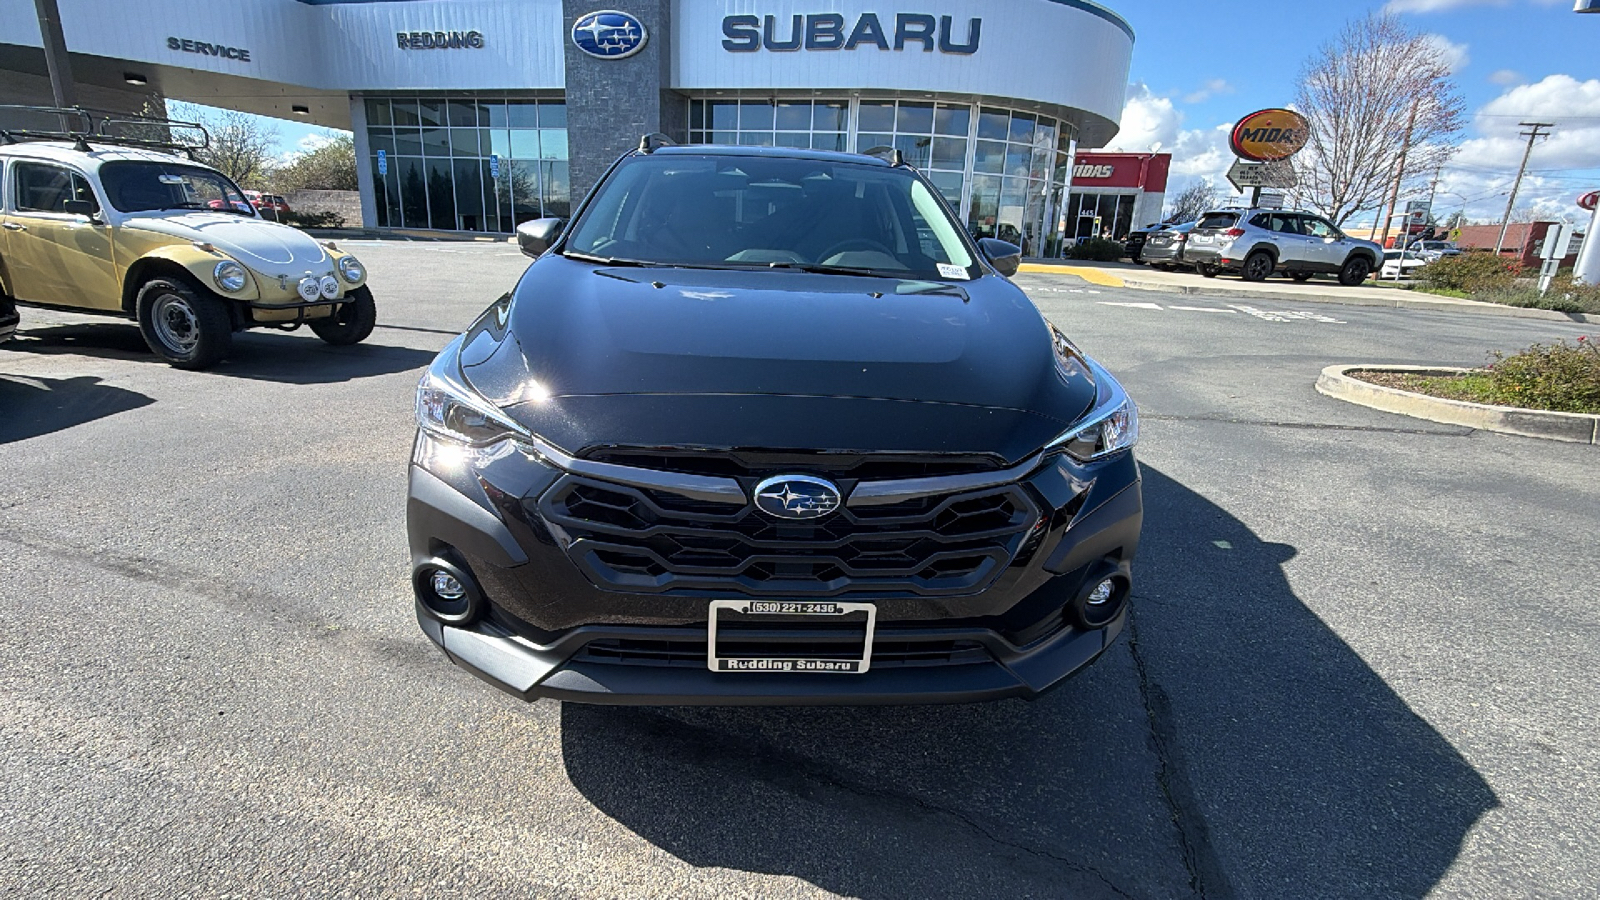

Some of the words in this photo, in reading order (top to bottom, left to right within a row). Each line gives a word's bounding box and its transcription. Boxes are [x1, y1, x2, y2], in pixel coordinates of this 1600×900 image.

[396, 31, 484, 49] REDDING
[721, 13, 982, 54] SUBARU
[167, 36, 251, 62] SERVICE
[727, 659, 792, 671] Redding
[796, 660, 851, 670] Subaru
